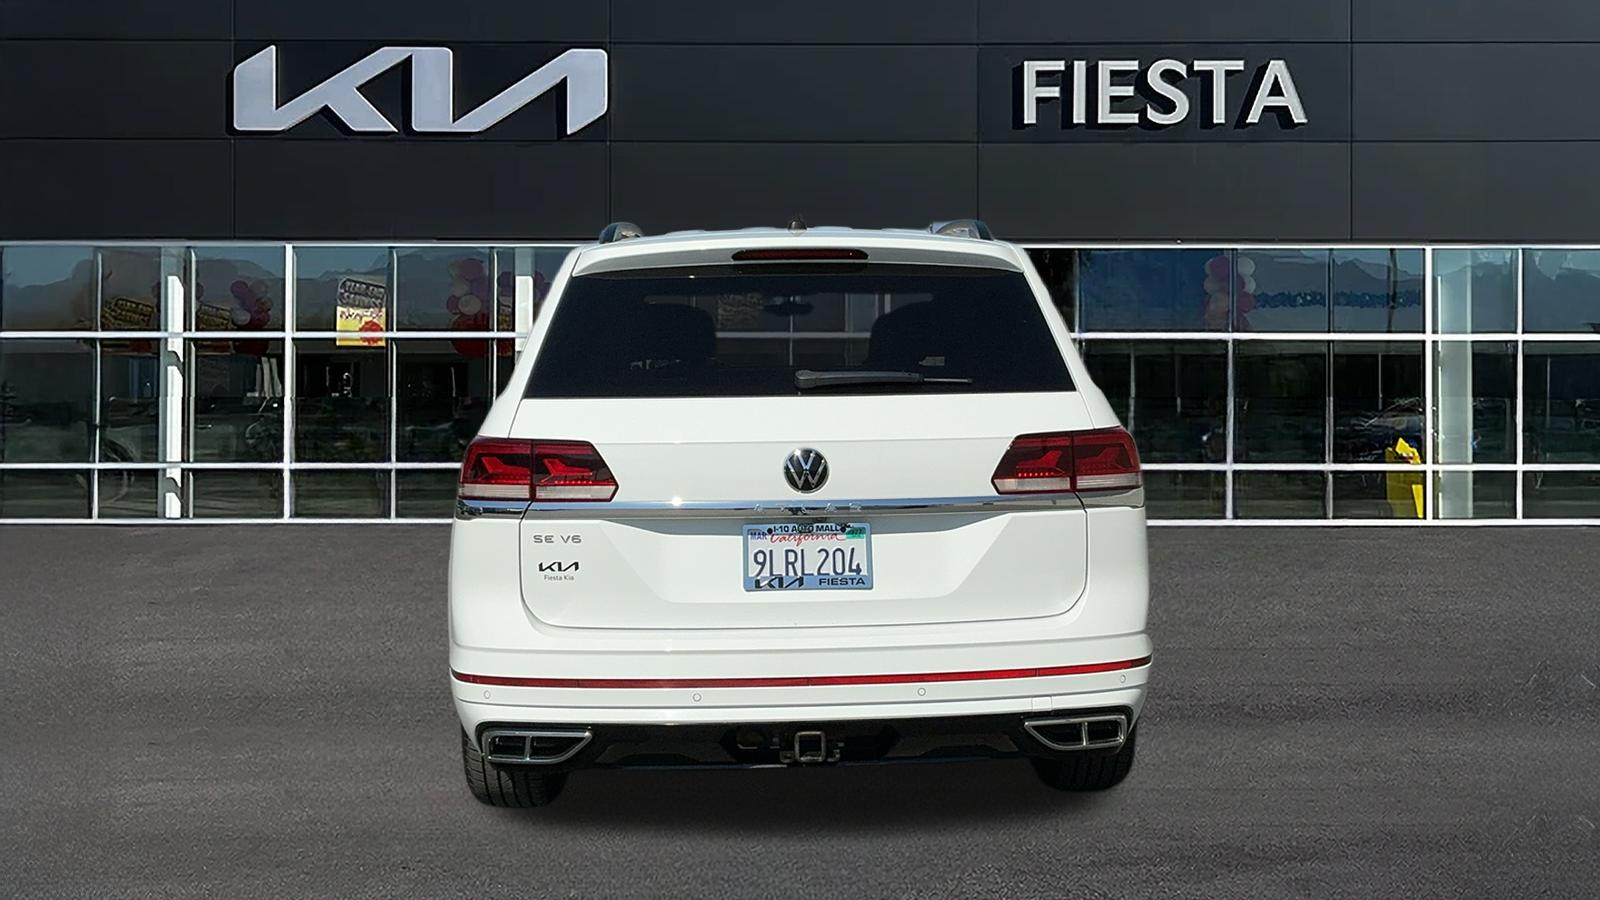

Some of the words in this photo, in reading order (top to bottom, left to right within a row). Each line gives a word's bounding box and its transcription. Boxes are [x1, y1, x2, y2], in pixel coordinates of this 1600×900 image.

[1023, 59, 1308, 125] FIESTA
[773, 525, 790, 533] I-10
[815, 524, 840, 532] MALL
[533, 534, 554, 543] SE
[560, 534, 582, 543] V6
[750, 531, 767, 540] MAR
[770, 532, 846, 547] California
[753, 547, 862, 577] 9LRL204
[818, 577, 866, 586] FIESTA
